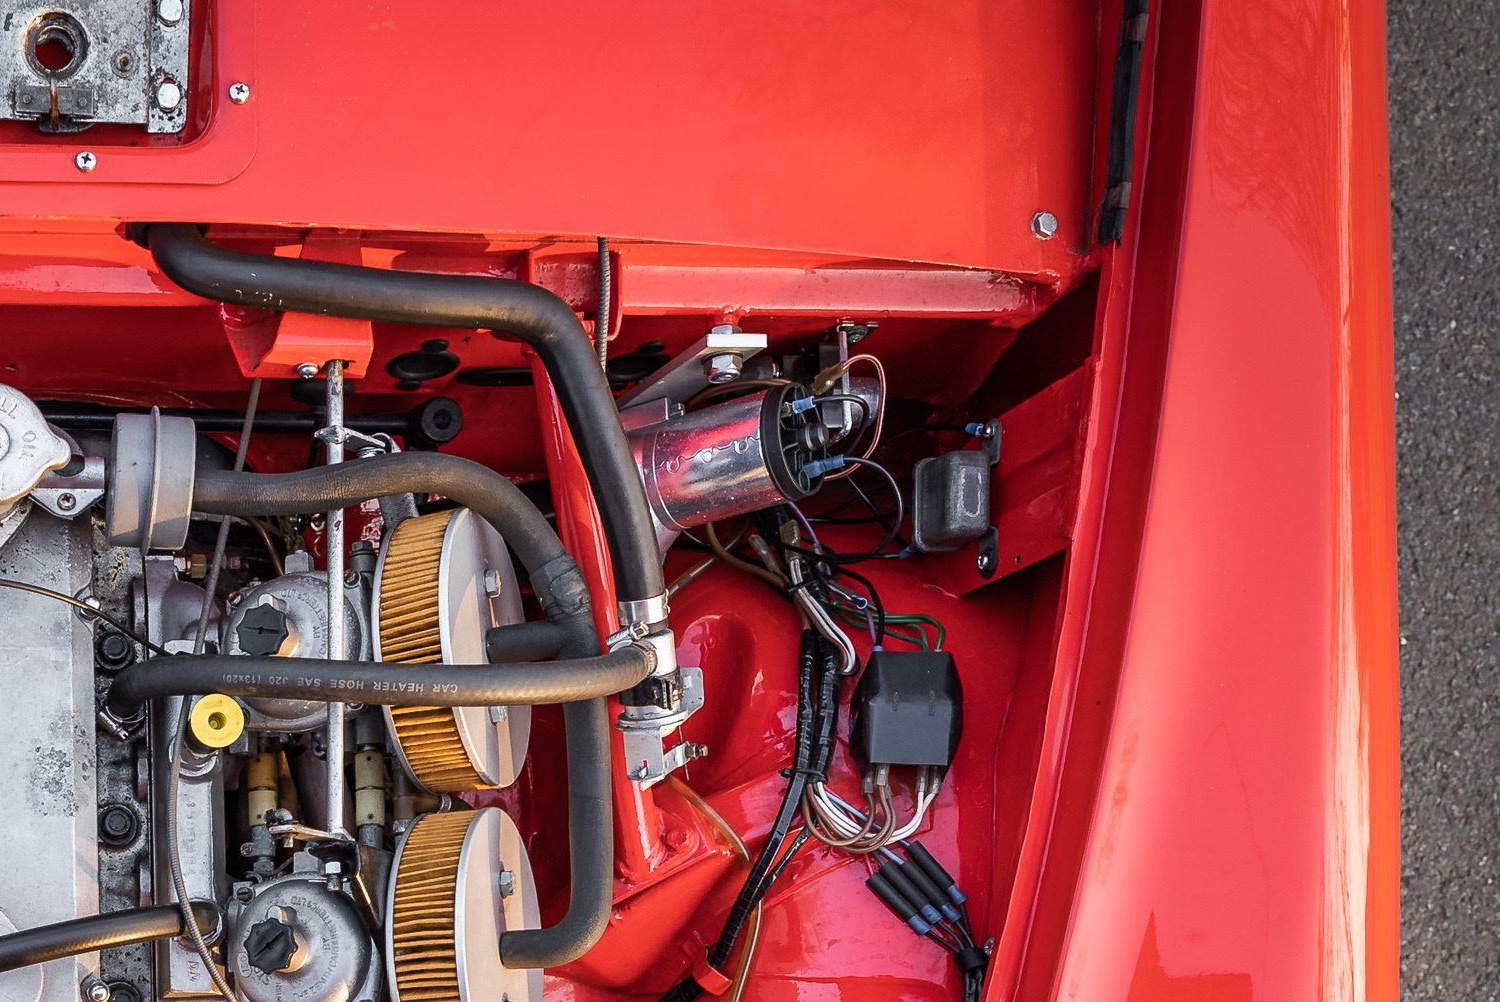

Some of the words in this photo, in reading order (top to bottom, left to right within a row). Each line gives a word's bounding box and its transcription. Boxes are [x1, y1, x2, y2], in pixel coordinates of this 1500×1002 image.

[19, 430, 37, 459] OIL
[268, 675, 289, 686] J20
[296, 676, 321, 688] SAE
[329, 678, 365, 690] HOSE
[373, 681, 424, 694] HEATER
[432, 682, 459, 694] CAR
[322, 937, 331, 952] BY
